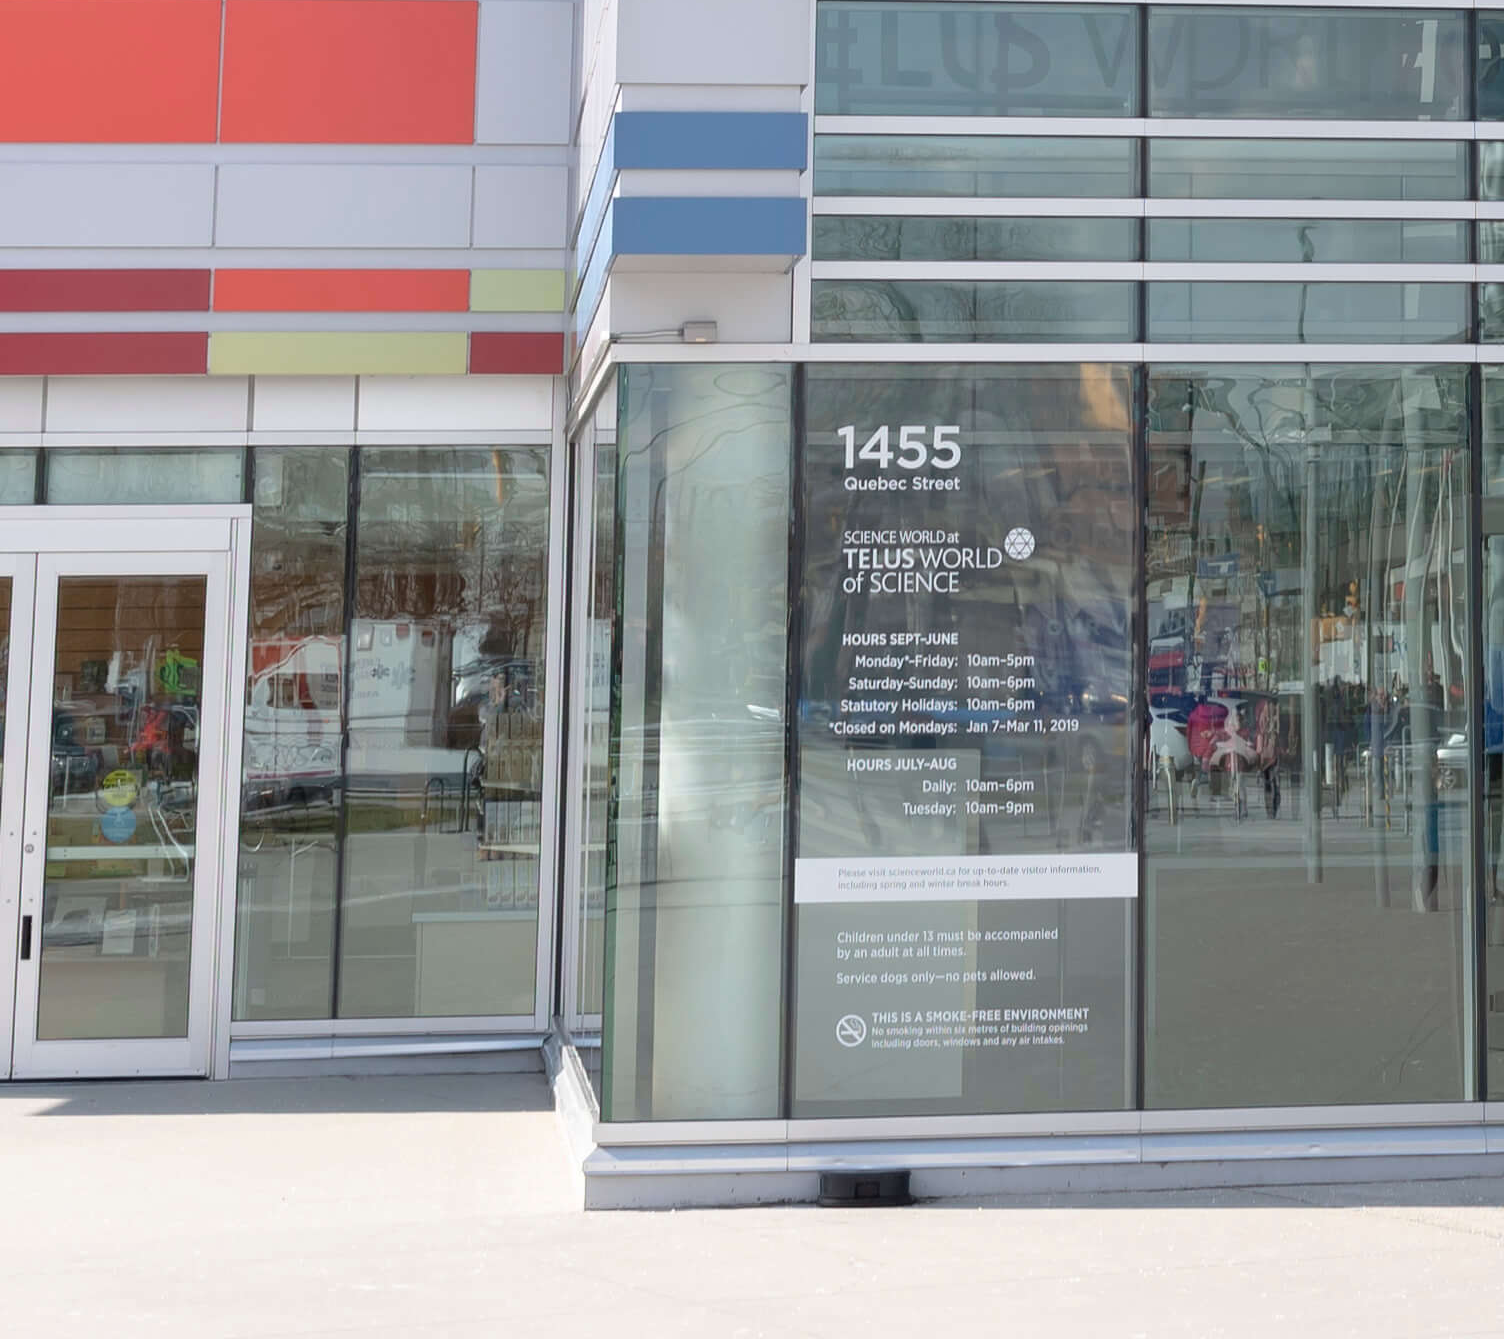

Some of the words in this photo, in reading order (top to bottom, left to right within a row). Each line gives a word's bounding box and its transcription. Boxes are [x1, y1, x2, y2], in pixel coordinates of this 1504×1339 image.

[837, 425, 961, 469] 1455
[844, 476, 907, 491] Quebec
[912, 476, 960, 491] Street
[844, 530, 896, 544] SCIENCE
[899, 530, 945, 544] WORLD
[947, 531, 960, 544] at
[842, 548, 915, 570] TELUS
[919, 548, 1002, 569] WORLD
[843, 571, 864, 594] of
[870, 571, 960, 593] SCIENCE
[842, 633, 887, 646] HOURS
[840, 698, 898, 714] Statutory
[902, 698, 958, 713] Holidays:
[879, 724, 895, 734] on
[899, 721, 958, 736] Mondays:
[966, 720, 988, 734] Jan
[1033, 720, 1047, 735] 11,
[1050, 719, 1079, 732] 2019
[847, 758, 892, 772] HOURS
[922, 779, 957, 795] Daily:
[902, 802, 956, 817] Tuesday:
[838, 867, 866, 877] Please
[868, 866, 886, 877] visit
[958, 866, 970, 876] for
[1021, 865, 1048, 875] visitor
[838, 880, 877, 891] including
[880, 880, 907, 891] spring
[908, 880, 925, 889] and
[927, 879, 955, 889] winter
[837, 931, 884, 944] Children
[887, 930, 919, 943] under
[923, 930, 934, 942] 13
[937, 930, 964, 942] must
[967, 929, 982, 941] be
[984, 928, 1059, 942] accompanied
[837, 946, 850, 960] by
[853, 948, 868, 958] an
[871, 945, 899, 958] adult
[902, 946, 914, 957] at
[916, 945, 930, 957] all
[933, 945, 967, 957] times.
[836, 971, 878, 984] Service
[880, 971, 908, 985] dogs
[963, 969, 987, 983] pets
[990, 968, 1036, 981] allowed.
[872, 1012, 898, 1023] THIS
[901, 1011, 912, 1023] IS
[914, 1011, 923, 1022] A
[926, 1009, 1001, 1022] SMOKE-FREE
[1004, 1007, 1089, 1021] ENVIRONMENT
[872, 1026, 885, 1036] No
[886, 1025, 923, 1036] smoking
[925, 1025, 952, 1036] within
[968, 1024, 998, 1034] metres
[1000, 1023, 1009, 1033] of
[1011, 1022, 1047, 1034] building
[1048, 1022, 1088, 1034] openings
[872, 1038, 912, 1050] including
[943, 1037, 981, 1048] windows
[983, 1036, 999, 1046] and
[1001, 1036, 1017, 1047] any
[1018, 1035, 1030, 1045] air
